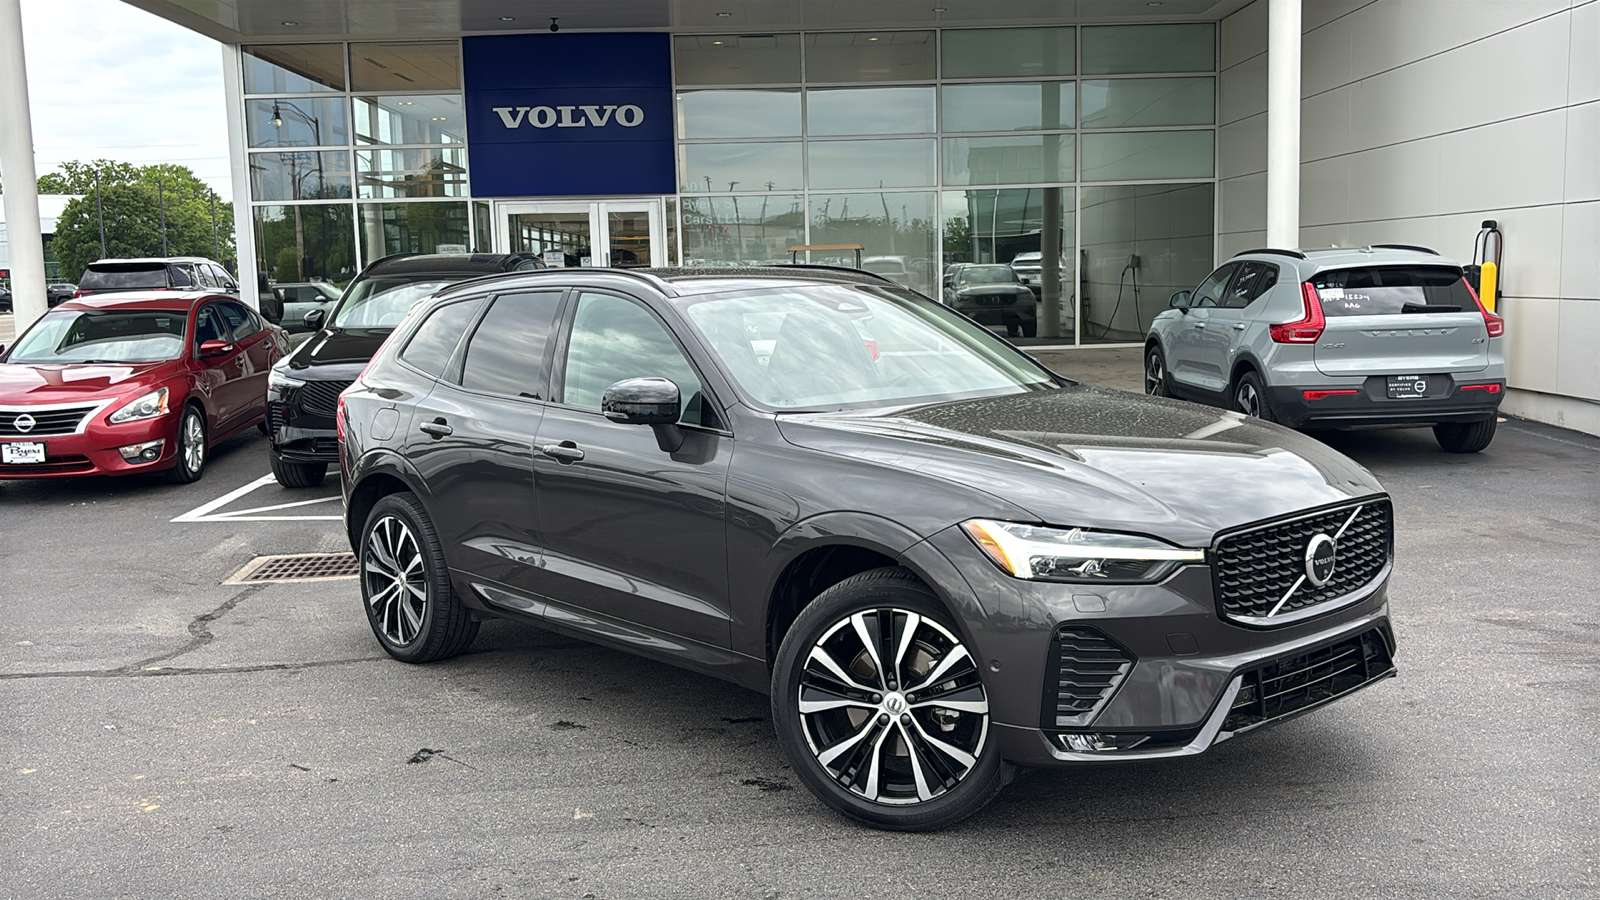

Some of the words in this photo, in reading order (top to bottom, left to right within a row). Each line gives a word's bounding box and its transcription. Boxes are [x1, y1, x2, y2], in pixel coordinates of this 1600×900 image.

[492, 104, 645, 129] VOLVO
[683, 199, 720, 212] Byers
[683, 213, 714, 225] Cars
[717, 213, 742, 225] LLC
[1372, 328, 1447, 337] VOLVO
[9, 446, 40, 457] Byers
